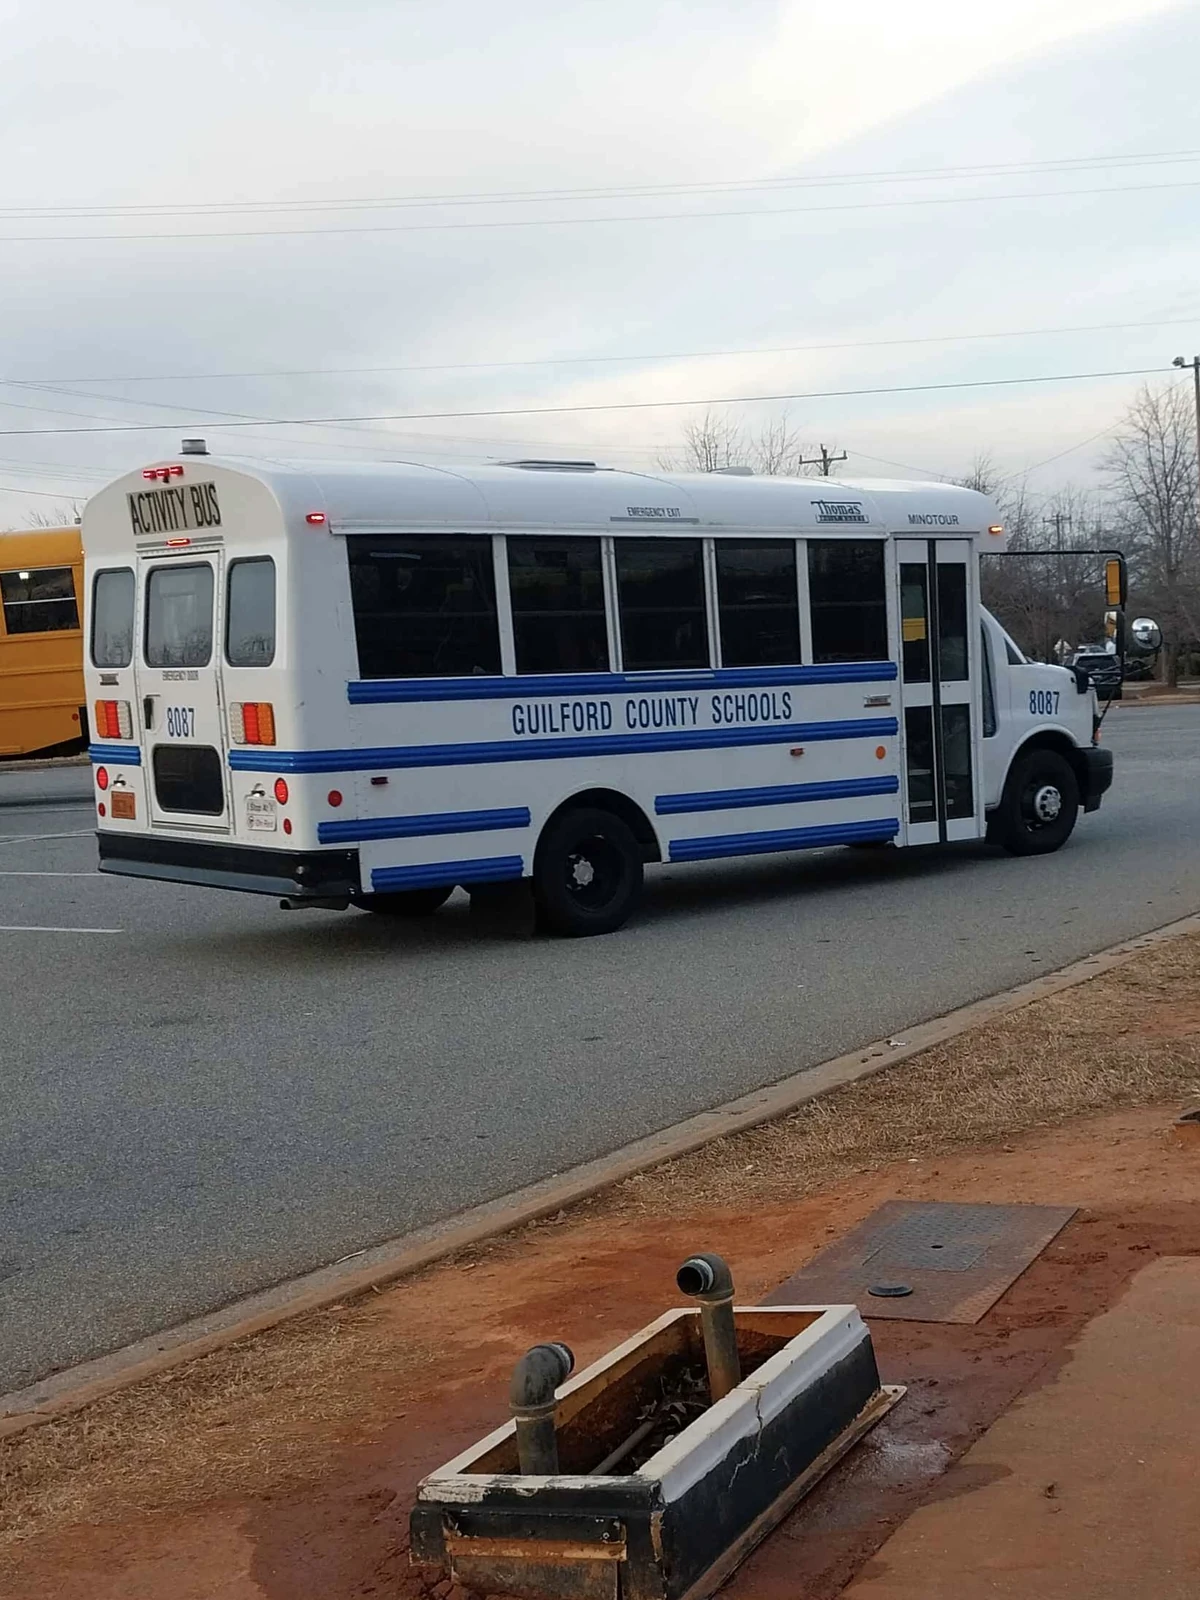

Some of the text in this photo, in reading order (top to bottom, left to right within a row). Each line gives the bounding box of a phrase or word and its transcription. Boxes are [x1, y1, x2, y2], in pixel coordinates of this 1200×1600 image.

[129, 483, 221, 535] ACTIVITY BUS
[626, 506, 681, 518] EMERGENCY EXIT
[810, 500, 862, 515] Thomas
[908, 513, 960, 526] MINOTOUR
[512, 691, 792, 735] GUILFORD COUNTY SCHOOLS
[1029, 690, 1060, 716] 8087
[167, 707, 195, 737] 8087
